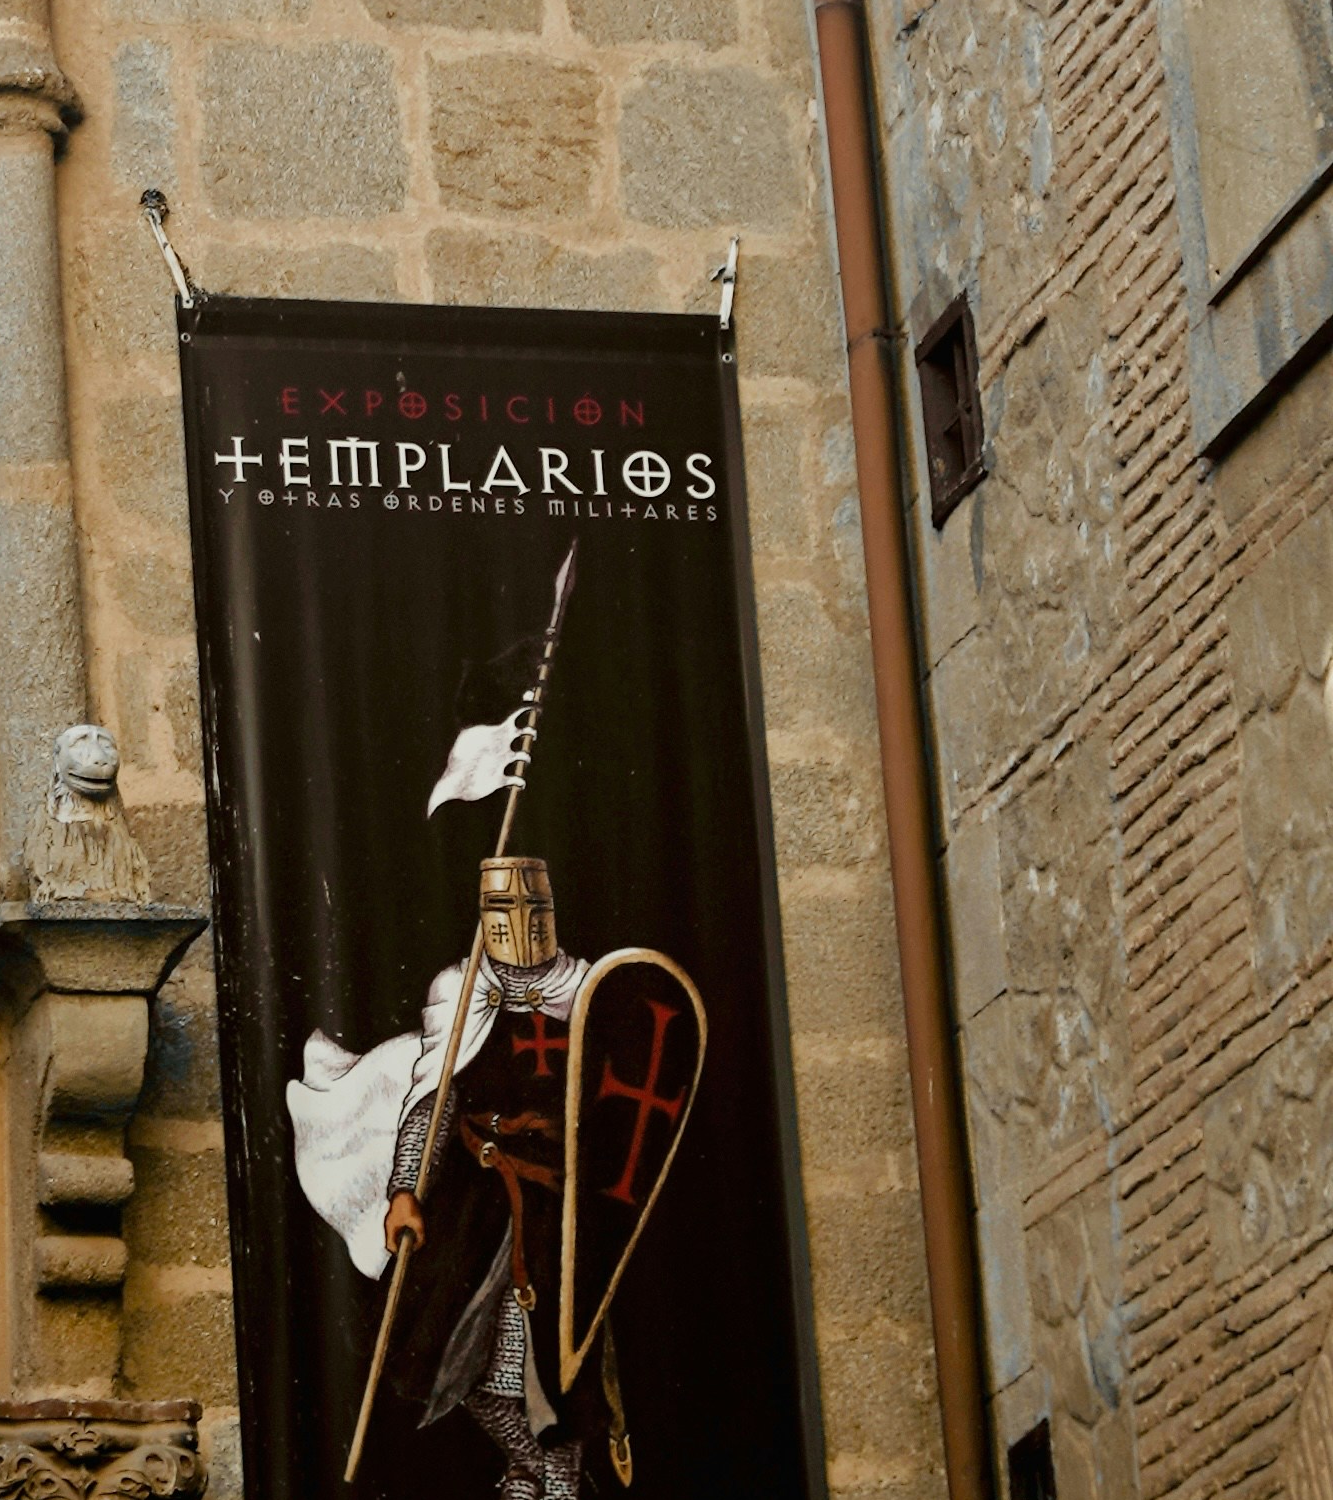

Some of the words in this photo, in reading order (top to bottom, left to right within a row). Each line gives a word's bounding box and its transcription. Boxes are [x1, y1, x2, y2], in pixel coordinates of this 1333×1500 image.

[280, 387, 645, 428] EXPOSICIÓN
[214, 435, 718, 501] TEMPLARIOS
[217, 488, 236, 505] Y
[257, 488, 361, 510] OTRAS
[382, 490, 527, 516] ÓRDENES
[547, 498, 718, 523] MILITARES
